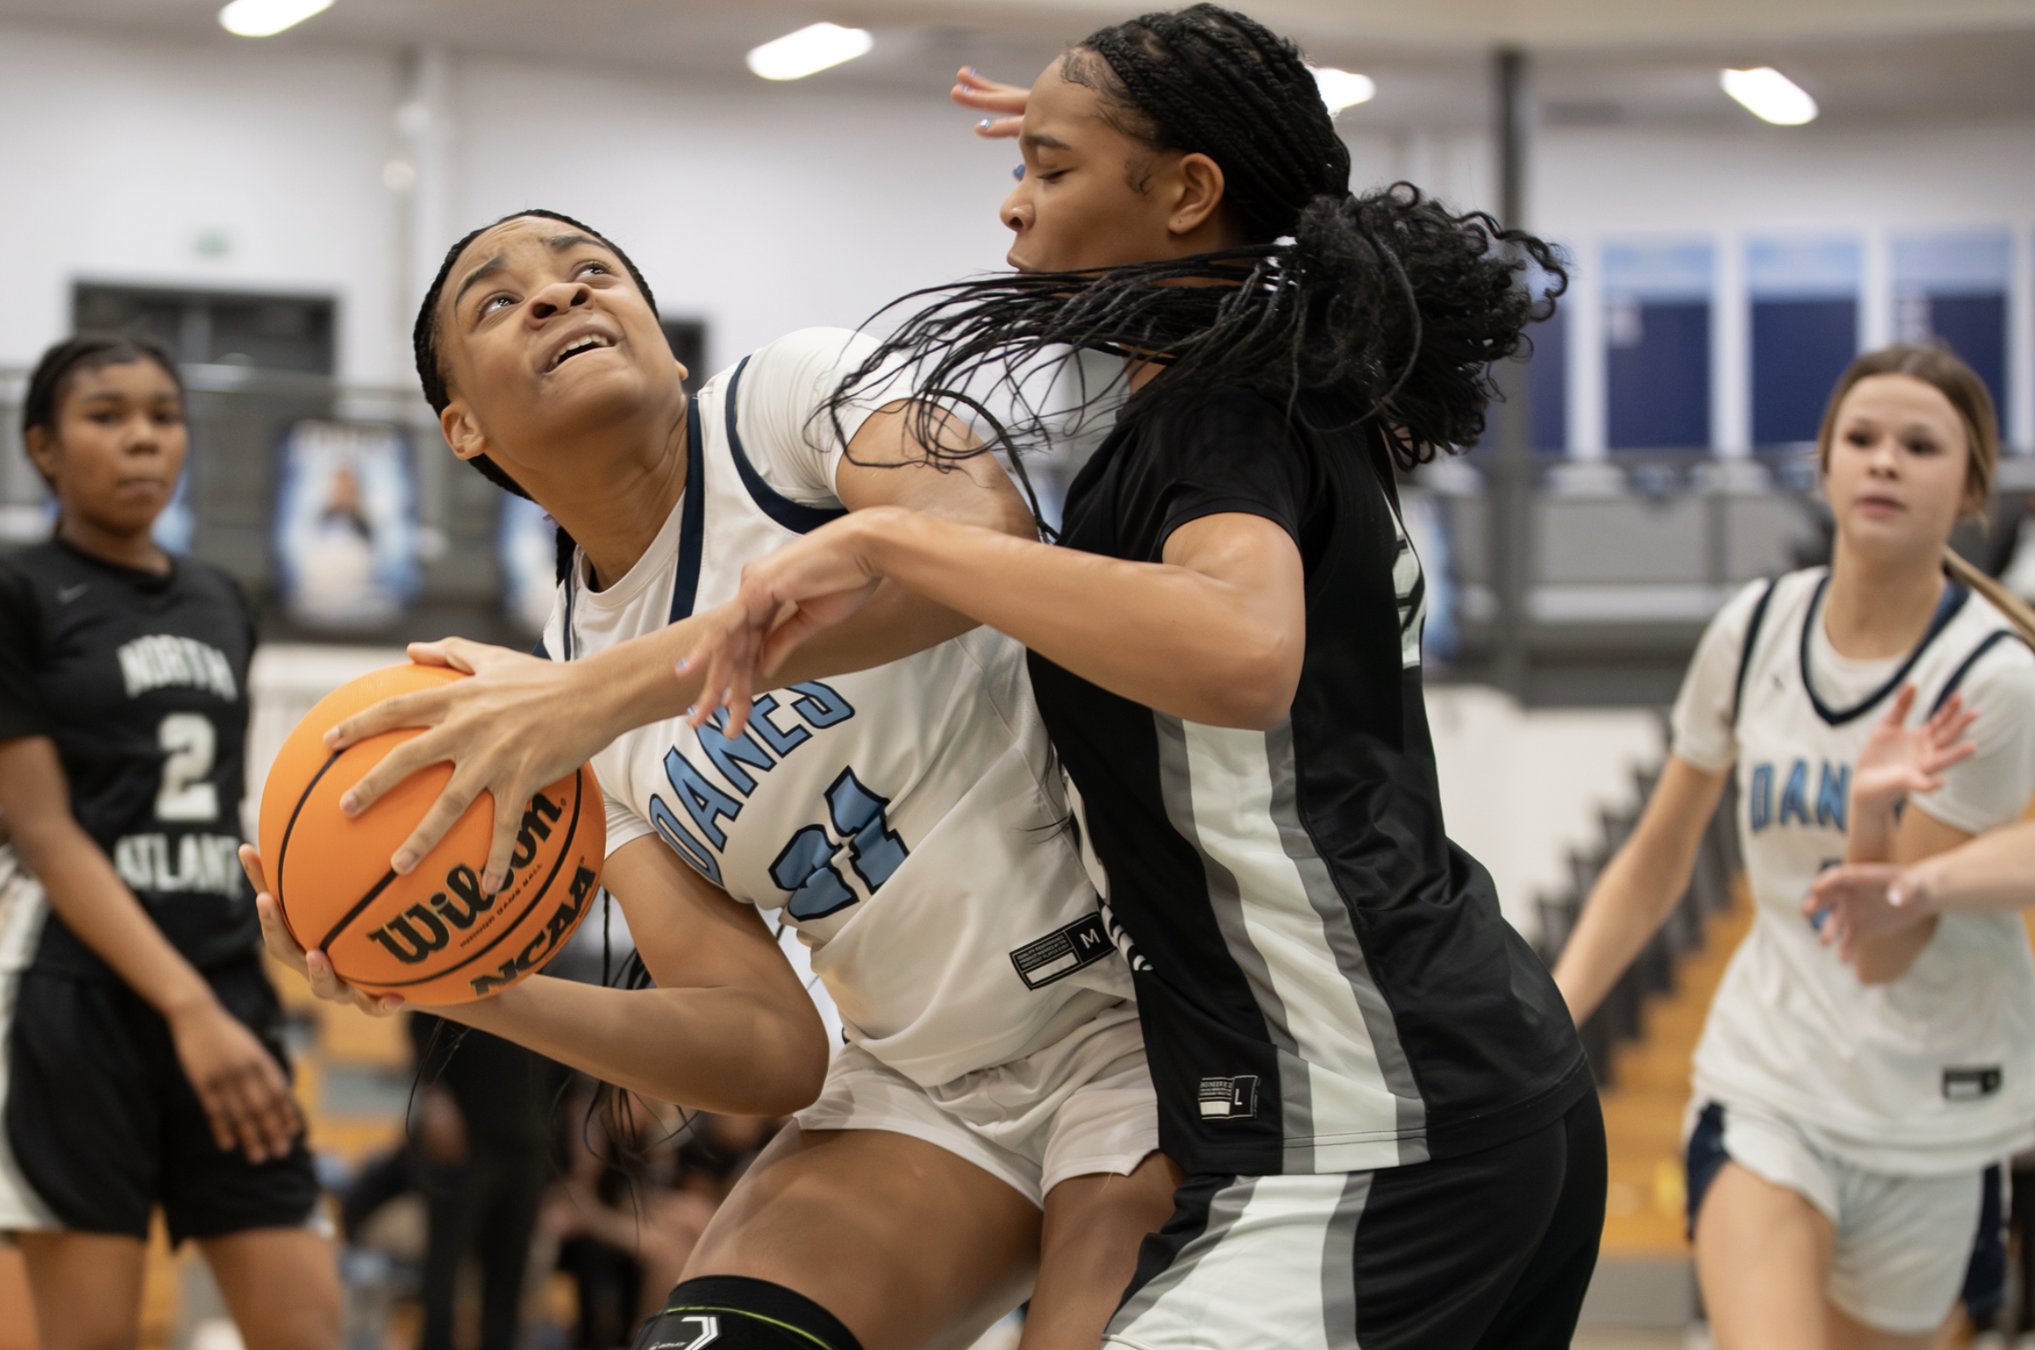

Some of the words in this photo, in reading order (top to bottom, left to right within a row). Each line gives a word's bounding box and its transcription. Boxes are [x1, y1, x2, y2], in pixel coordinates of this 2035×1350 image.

[116, 633, 239, 701] NORTH
[156, 711, 218, 821] 2
[649, 679, 856, 890] DANES
[114, 831, 242, 901] ATLANT
[366, 790, 564, 966] Wilon
[469, 864, 597, 997] NCAA
[1080, 928, 1101, 949] M
[1234, 1088, 1243, 1106] L
